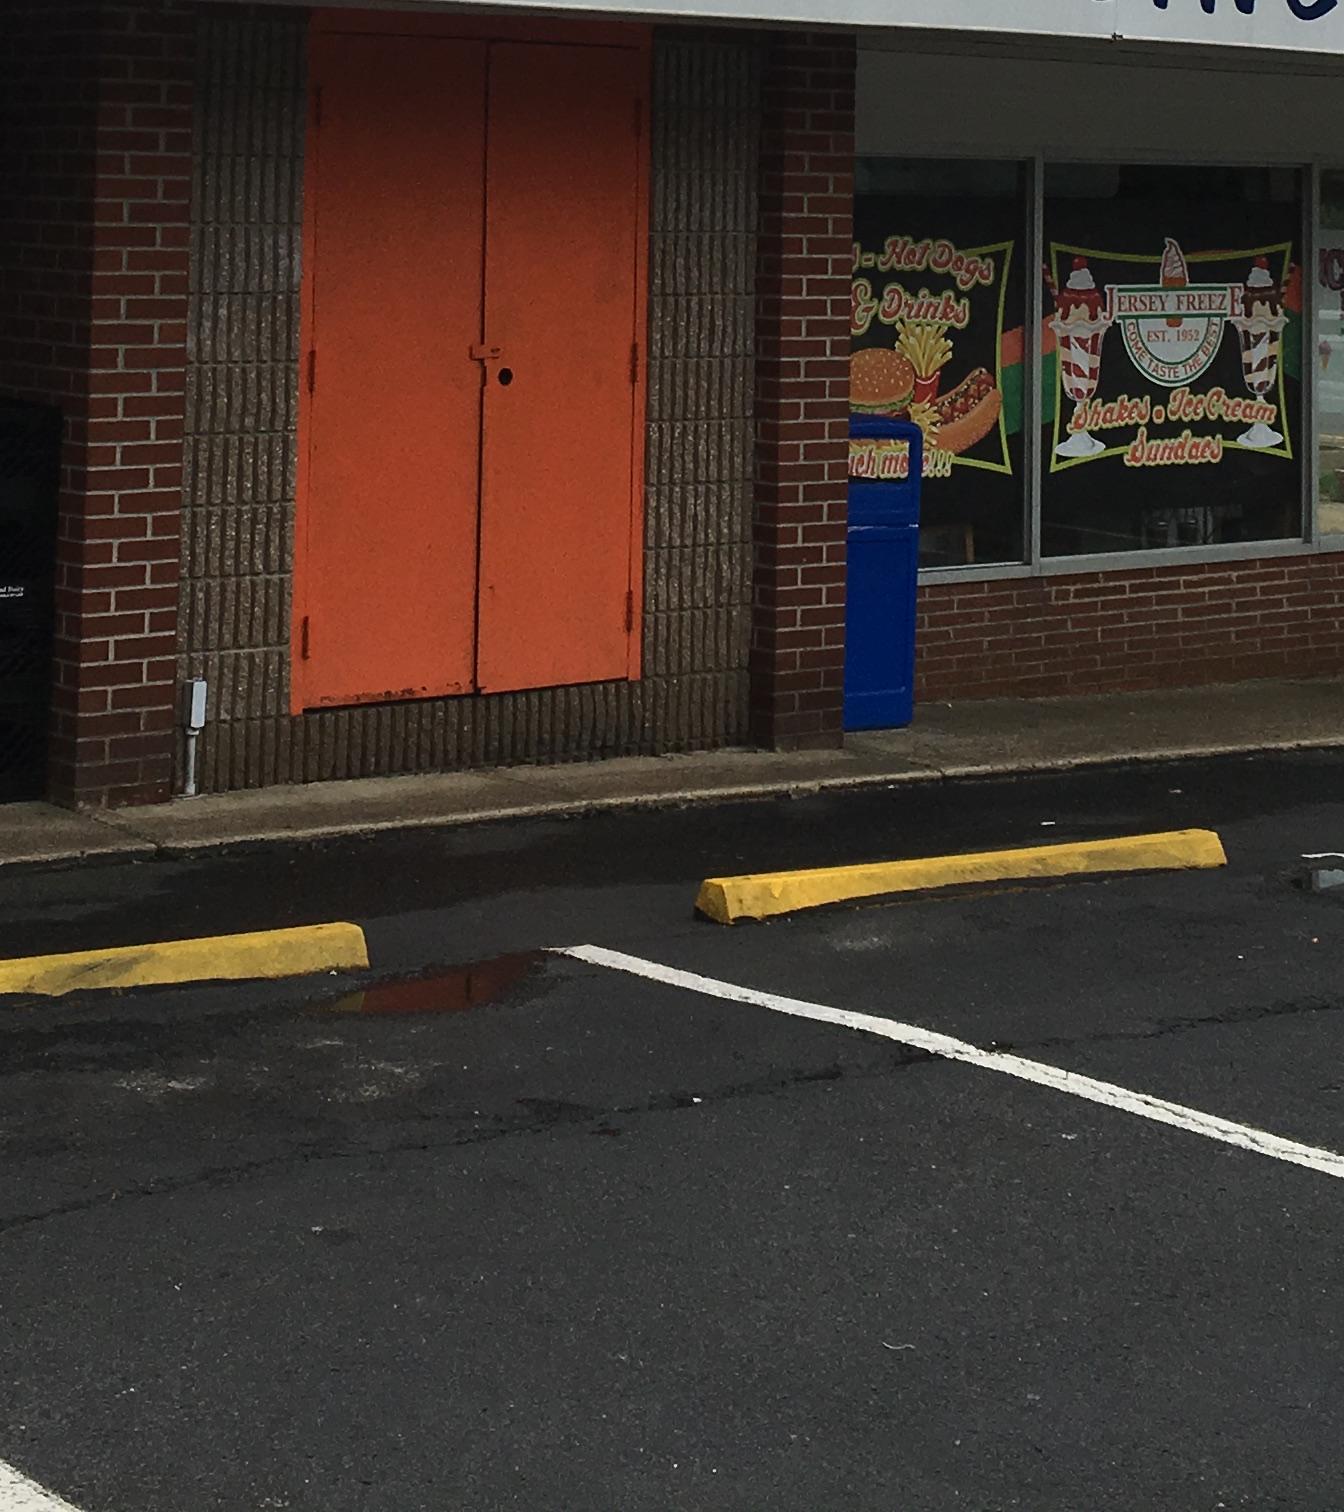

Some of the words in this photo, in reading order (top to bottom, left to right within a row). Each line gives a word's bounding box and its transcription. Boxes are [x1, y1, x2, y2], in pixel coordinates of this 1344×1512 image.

[879, 237, 930, 272] Hot
[930, 242, 993, 289] Dogs
[880, 285, 969, 328] Drinks
[1103, 286, 1169, 320] JERSEY
[1176, 285, 1244, 317] FREEZE
[1127, 321, 1148, 362] COME
[1147, 357, 1180, 379] TASTE
[1182, 354, 1204, 376] THE
[1201, 320, 1219, 357] BEST
[1147, 329, 1172, 343] EST.
[1176, 329, 1200, 342] 1952
[1069, 396, 1151, 433] Shakes
[1168, 388, 1206, 421] Ice
[1206, 388, 1277, 424] Cream
[879, 449, 953, 478] moe!!!
[1125, 428, 1223, 466] Sundaes
